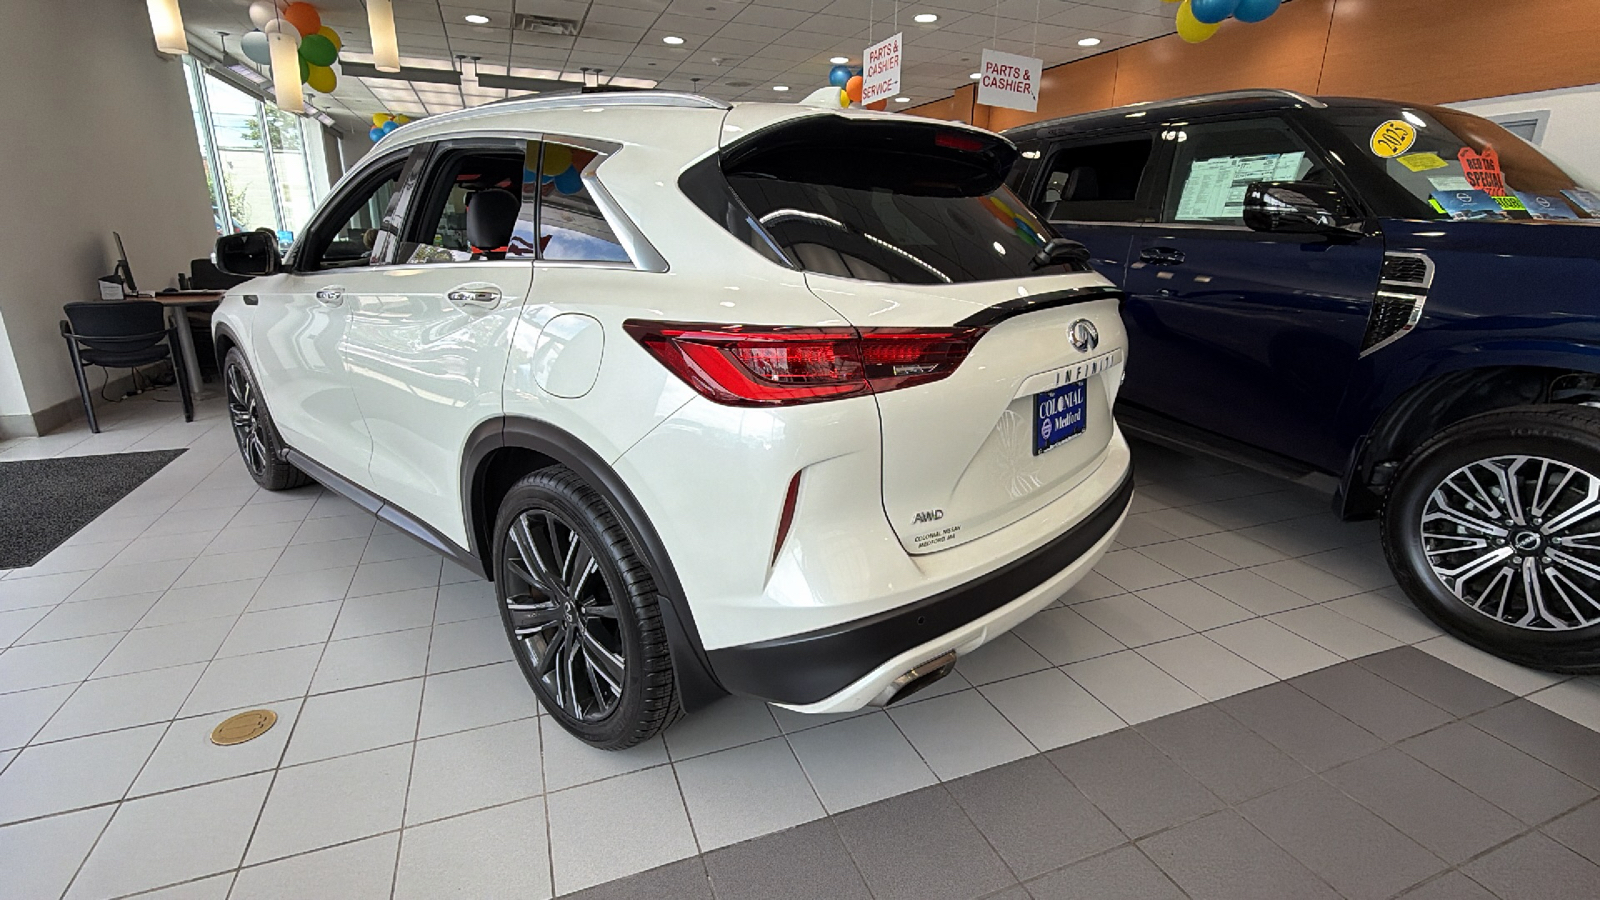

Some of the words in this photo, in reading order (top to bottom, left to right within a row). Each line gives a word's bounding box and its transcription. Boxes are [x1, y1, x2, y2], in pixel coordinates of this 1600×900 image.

[869, 43, 892, 64] PARTS
[892, 39, 899, 54] &
[867, 54, 900, 78] CASHIER
[985, 61, 1021, 79] PARTS
[1022, 69, 1031, 81] &
[862, 78, 893, 101] SERVICE
[982, 75, 1032, 95] CASHIER
[1377, 122, 1409, 154] 2025
[1466, 158, 1482, 170] RED
[1482, 158, 1496, 171] TAG
[1466, 171, 1504, 189] SPECIAL
[1055, 354, 1114, 386] INFINITI
[1039, 388, 1084, 419] COLONIAL
[1054, 408, 1082, 432] Medford
[910, 509, 944, 525] AWD
